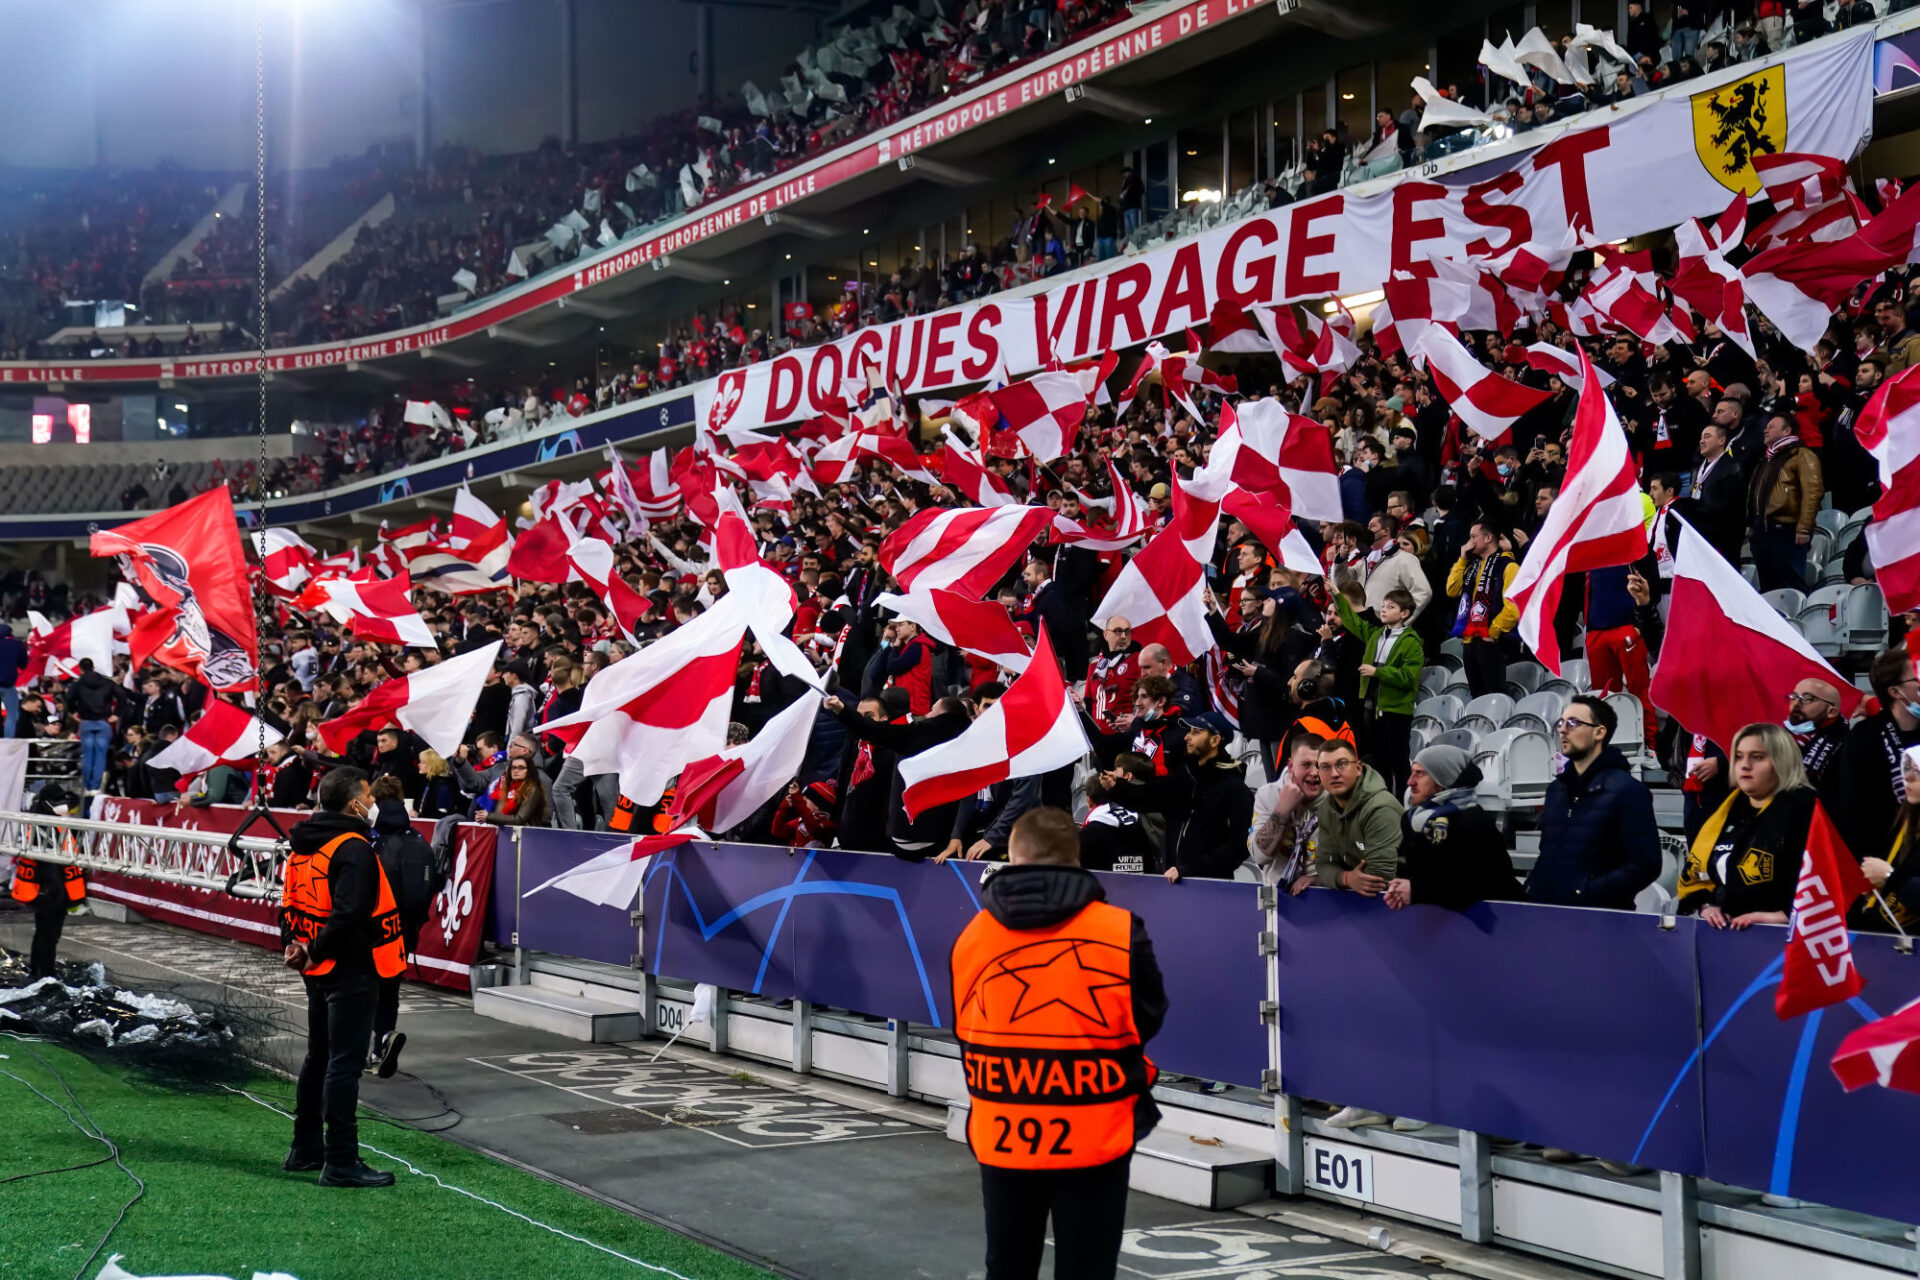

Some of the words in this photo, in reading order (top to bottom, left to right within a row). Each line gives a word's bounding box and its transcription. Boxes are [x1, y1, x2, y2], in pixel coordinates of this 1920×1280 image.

[901, 91, 1007, 153] MÉTROPOLE
[1021, 24, 1163, 104] EUROPÉENNE
[1179, 4, 1209, 36] DE
[660, 206, 742, 254] EUROPÉENNE
[750, 195, 767, 217] DE
[776, 175, 815, 206] LILLE
[764, 304, 1002, 423] DOGUES
[1034, 195, 1344, 365] VIRAGE
[1391, 126, 1610, 279] EST
[295, 343, 387, 368] EUROPÉENNE
[395, 338, 410, 352] DE
[418, 328, 448, 347] LILLE
[28, 369, 83, 382] LILLE
[659, 1004, 683, 1031] D04
[965, 1052, 1127, 1096] STEWARD
[994, 1116, 1073, 1155] 292
[1315, 1148, 1363, 1194] E01
